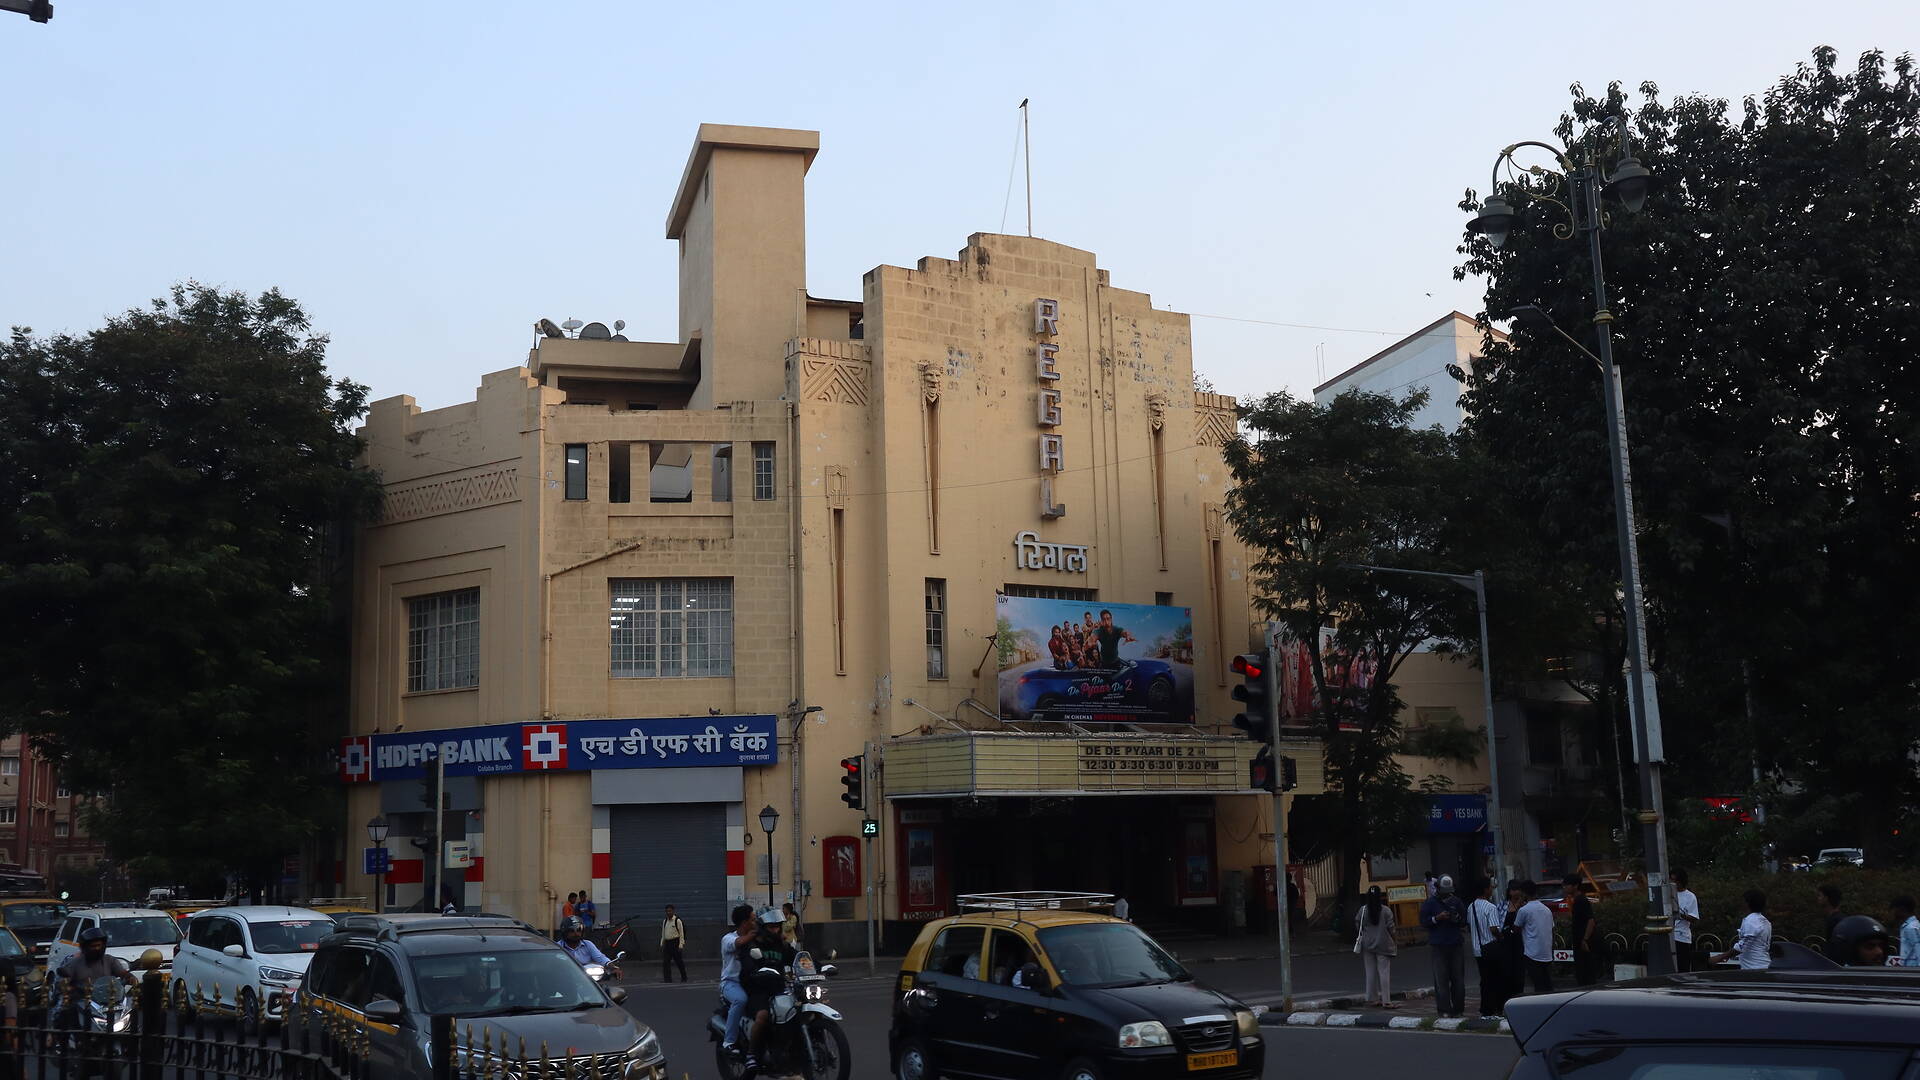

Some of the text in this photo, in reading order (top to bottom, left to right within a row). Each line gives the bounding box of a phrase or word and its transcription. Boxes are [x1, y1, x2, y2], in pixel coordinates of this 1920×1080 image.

[1035, 298, 1066, 519] REGAL
[1014, 531, 1088, 572] रिगल
[376, 736, 512, 769] HDFC BANK
[579, 736, 617, 761] एच
[619, 727, 649, 755] डी
[651, 734, 690, 759] एफ
[692, 725, 724, 753] सी
[1086, 746, 1101, 755] DE
[1105, 746, 1120, 755] DE
[1125, 746, 1163, 755] PYAAR
[1168, 747, 1183, 756] DE
[1187, 747, 1195, 756] 2
[1086, 760, 1219, 770] 12:30 3:30 6:30 9:30 PM
[1455, 808, 1483, 818] YES BANK
[864, 824, 876, 833] 25
